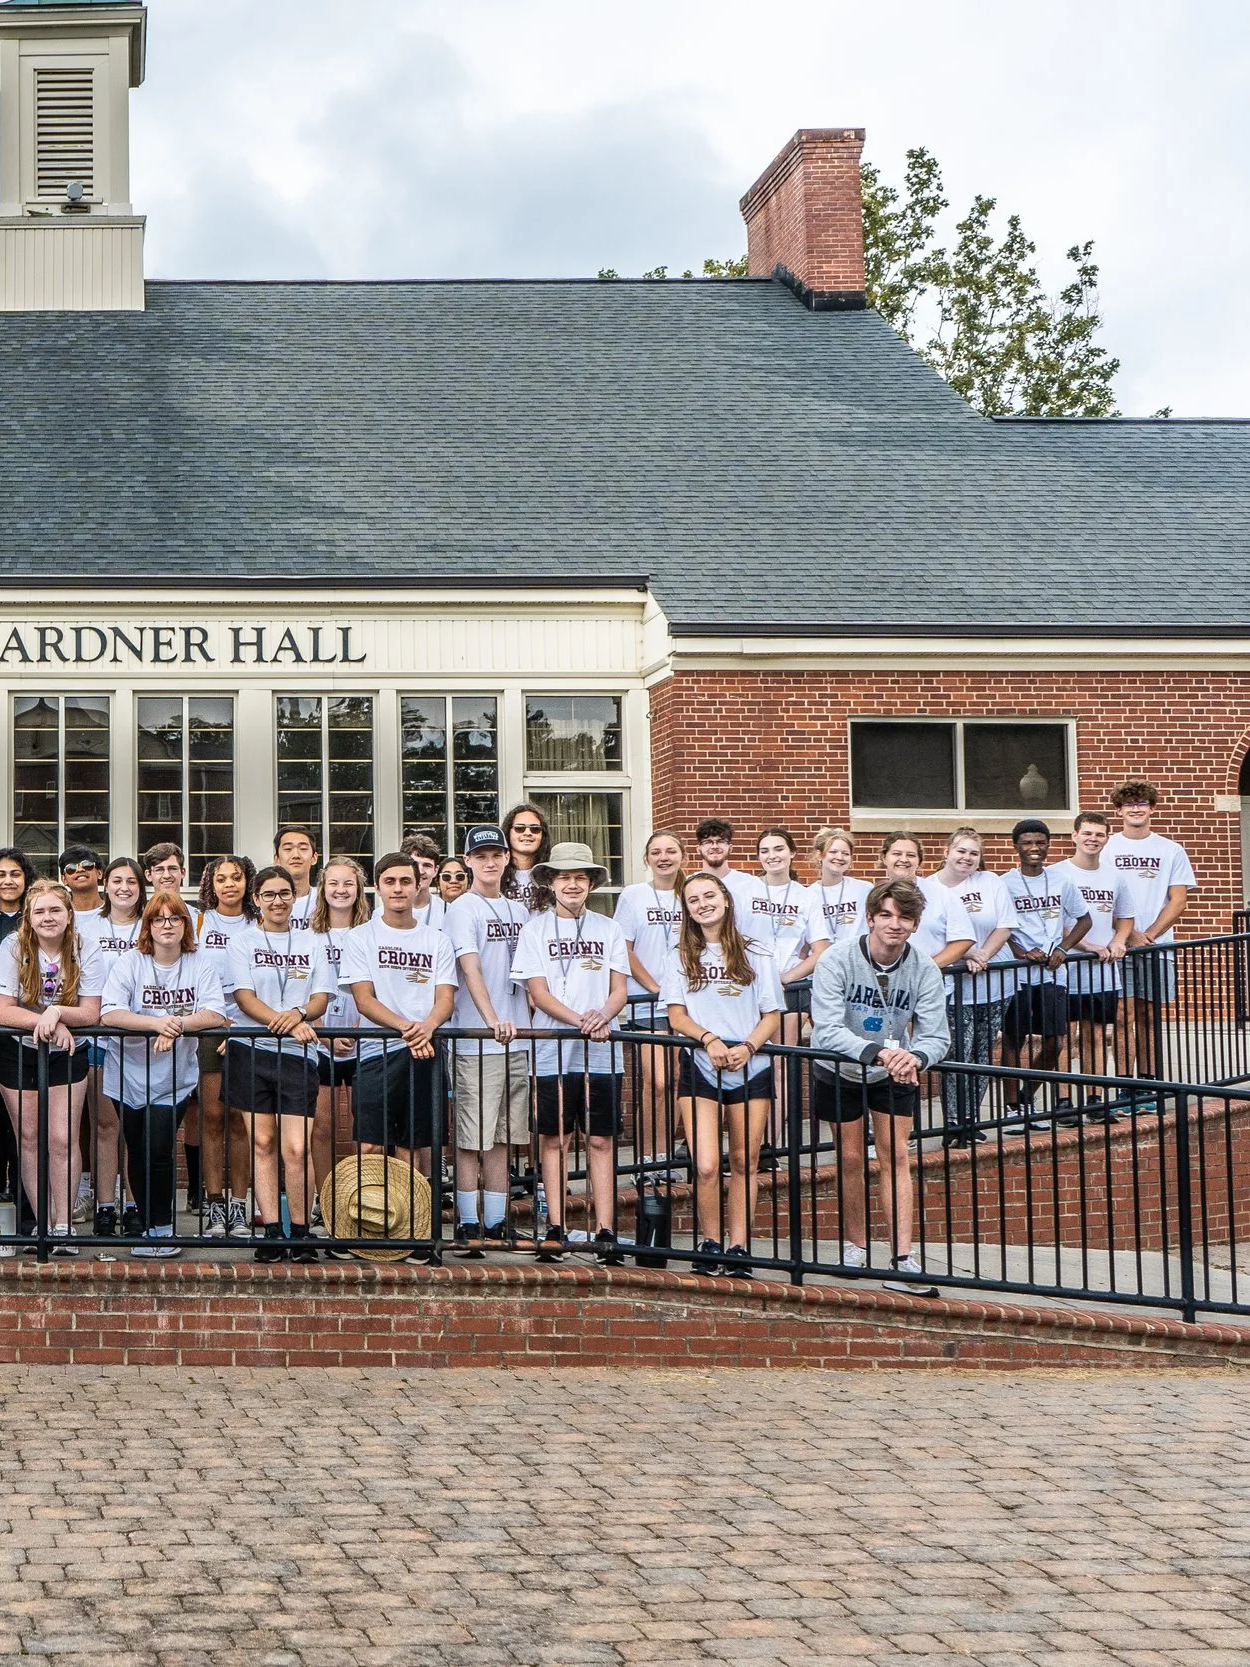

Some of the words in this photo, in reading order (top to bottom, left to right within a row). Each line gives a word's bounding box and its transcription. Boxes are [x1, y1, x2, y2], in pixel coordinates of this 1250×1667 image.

[230, 627, 367, 664] HALL
[1115, 857, 1161, 868] CROWN
[1015, 895, 1061, 910] CROWN
[1081, 889, 1114, 901] ROWN
[752, 900, 799, 914] CROWN
[823, 901, 857, 916] OWN
[647, 911, 683, 922] CROW
[99, 940, 139, 950] CROW
[549, 942, 604, 957] CROWN
[254, 952, 310, 967] CROWN
[378, 950, 433, 968] CROWN
[142, 986, 196, 1005] CROWN
[846, 983, 910, 1011] CARINA
